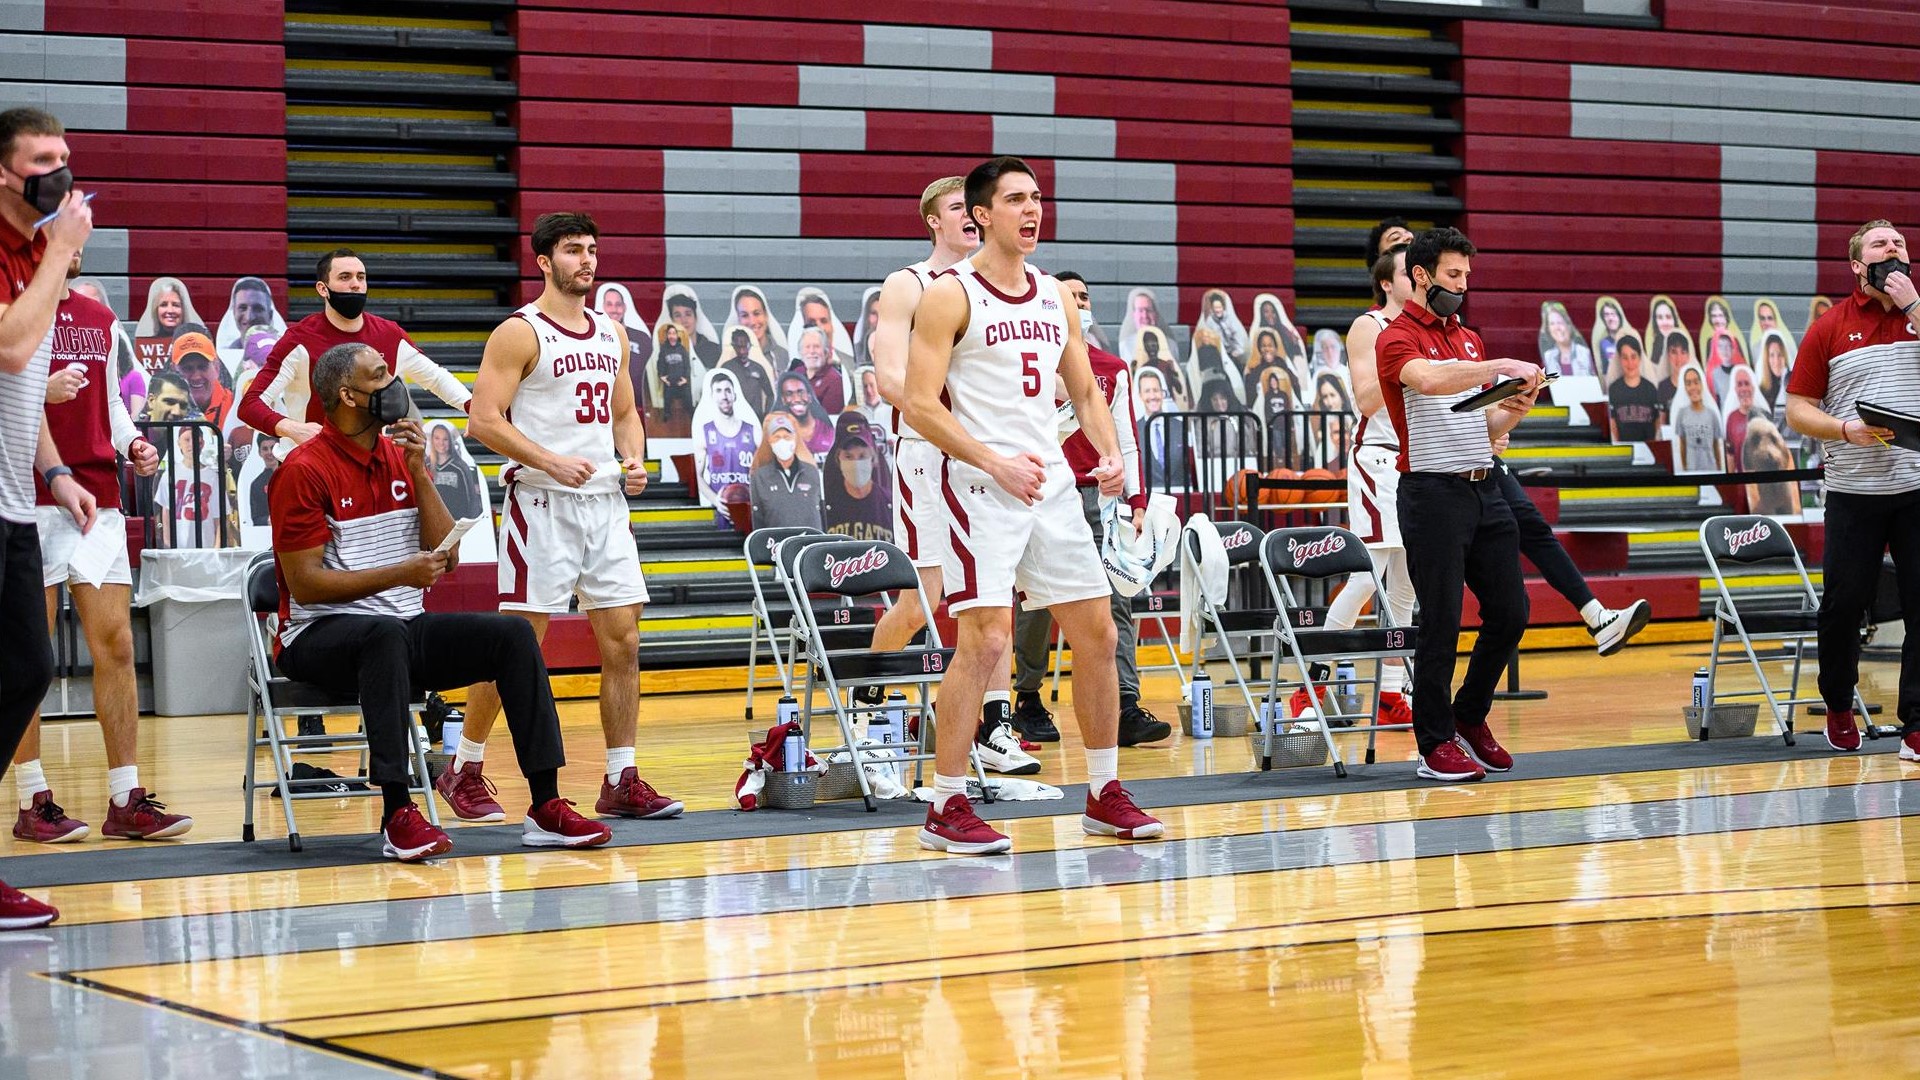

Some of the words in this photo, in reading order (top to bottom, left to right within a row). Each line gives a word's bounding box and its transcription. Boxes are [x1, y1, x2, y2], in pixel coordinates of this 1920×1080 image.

[985, 319, 1061, 347] COLGATE
[79, 353, 94, 361] ANY
[1464, 341, 1479, 359] C
[552, 351, 619, 379] COLGATE
[1021, 351, 1042, 398] 5
[575, 381, 611, 424] 33
[391, 479, 409, 502] C
[1148, 597, 1163, 611] 13
[834, 609, 850, 624] 13
[1299, 610, 1314, 626] 13
[1386, 631, 1405, 648] 13
[922, 652, 943, 672] 13
[1203, 689, 1211, 730] POWERADE
